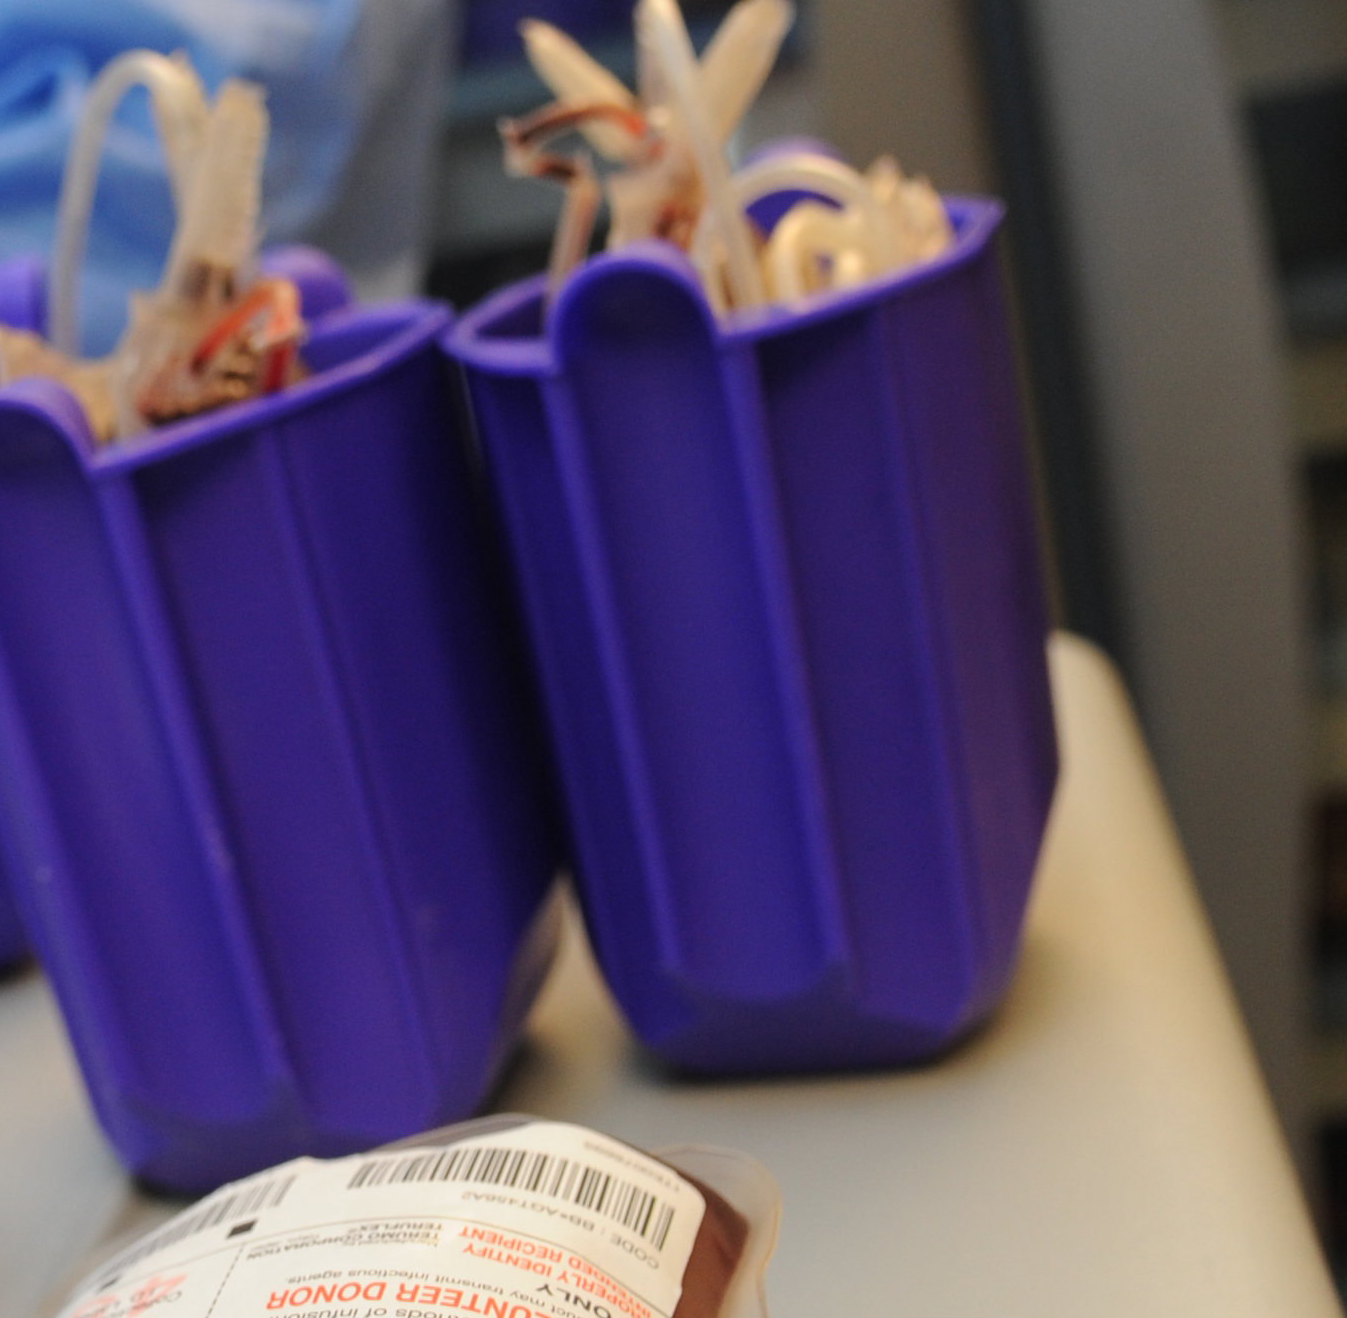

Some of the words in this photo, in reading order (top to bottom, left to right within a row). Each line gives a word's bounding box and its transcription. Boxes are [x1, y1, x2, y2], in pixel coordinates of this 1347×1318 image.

[247, 1234, 363, 1261] CORPORATION
[369, 1231, 439, 1241] TERUMO
[458, 1226, 563, 1263] RECIPIENT
[462, 1242, 552, 1278] IDENTIFY
[610, 1233, 660, 1270] CODE
[285, 1269, 343, 1285] agents.
[348, 1269, 430, 1282] infectious
[434, 1275, 504, 1296] transmit
[567, 1255, 651, 1318] INTENDED
[266, 1282, 386, 1310] DONOR
[509, 1290, 546, 1308] may
